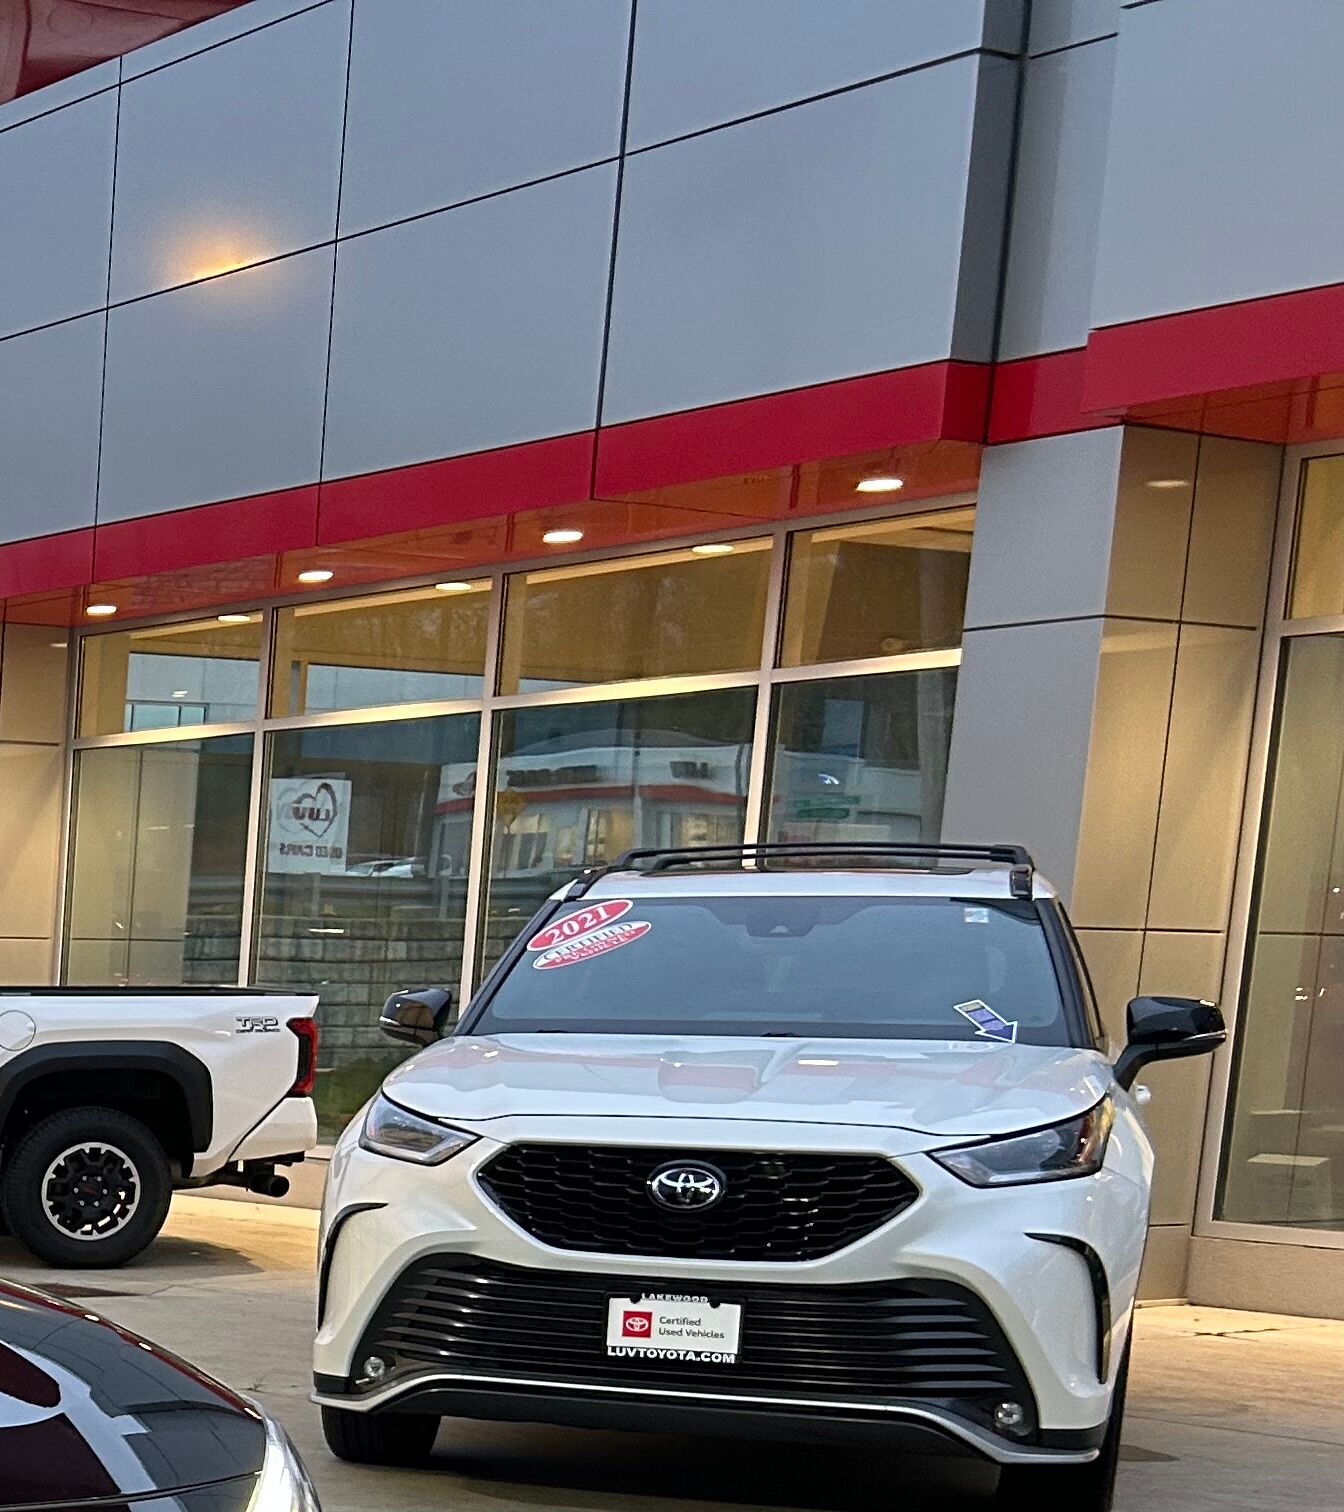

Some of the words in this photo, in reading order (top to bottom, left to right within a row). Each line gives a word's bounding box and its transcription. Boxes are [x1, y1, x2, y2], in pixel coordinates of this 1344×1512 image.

[545, 906, 611, 944] 2021
[659, 1316, 702, 1327] Certified
[658, 1328, 683, 1337] Used
[685, 1330, 725, 1339] Vehicles
[607, 1346, 736, 1364] LUVTOYOTA.COM
